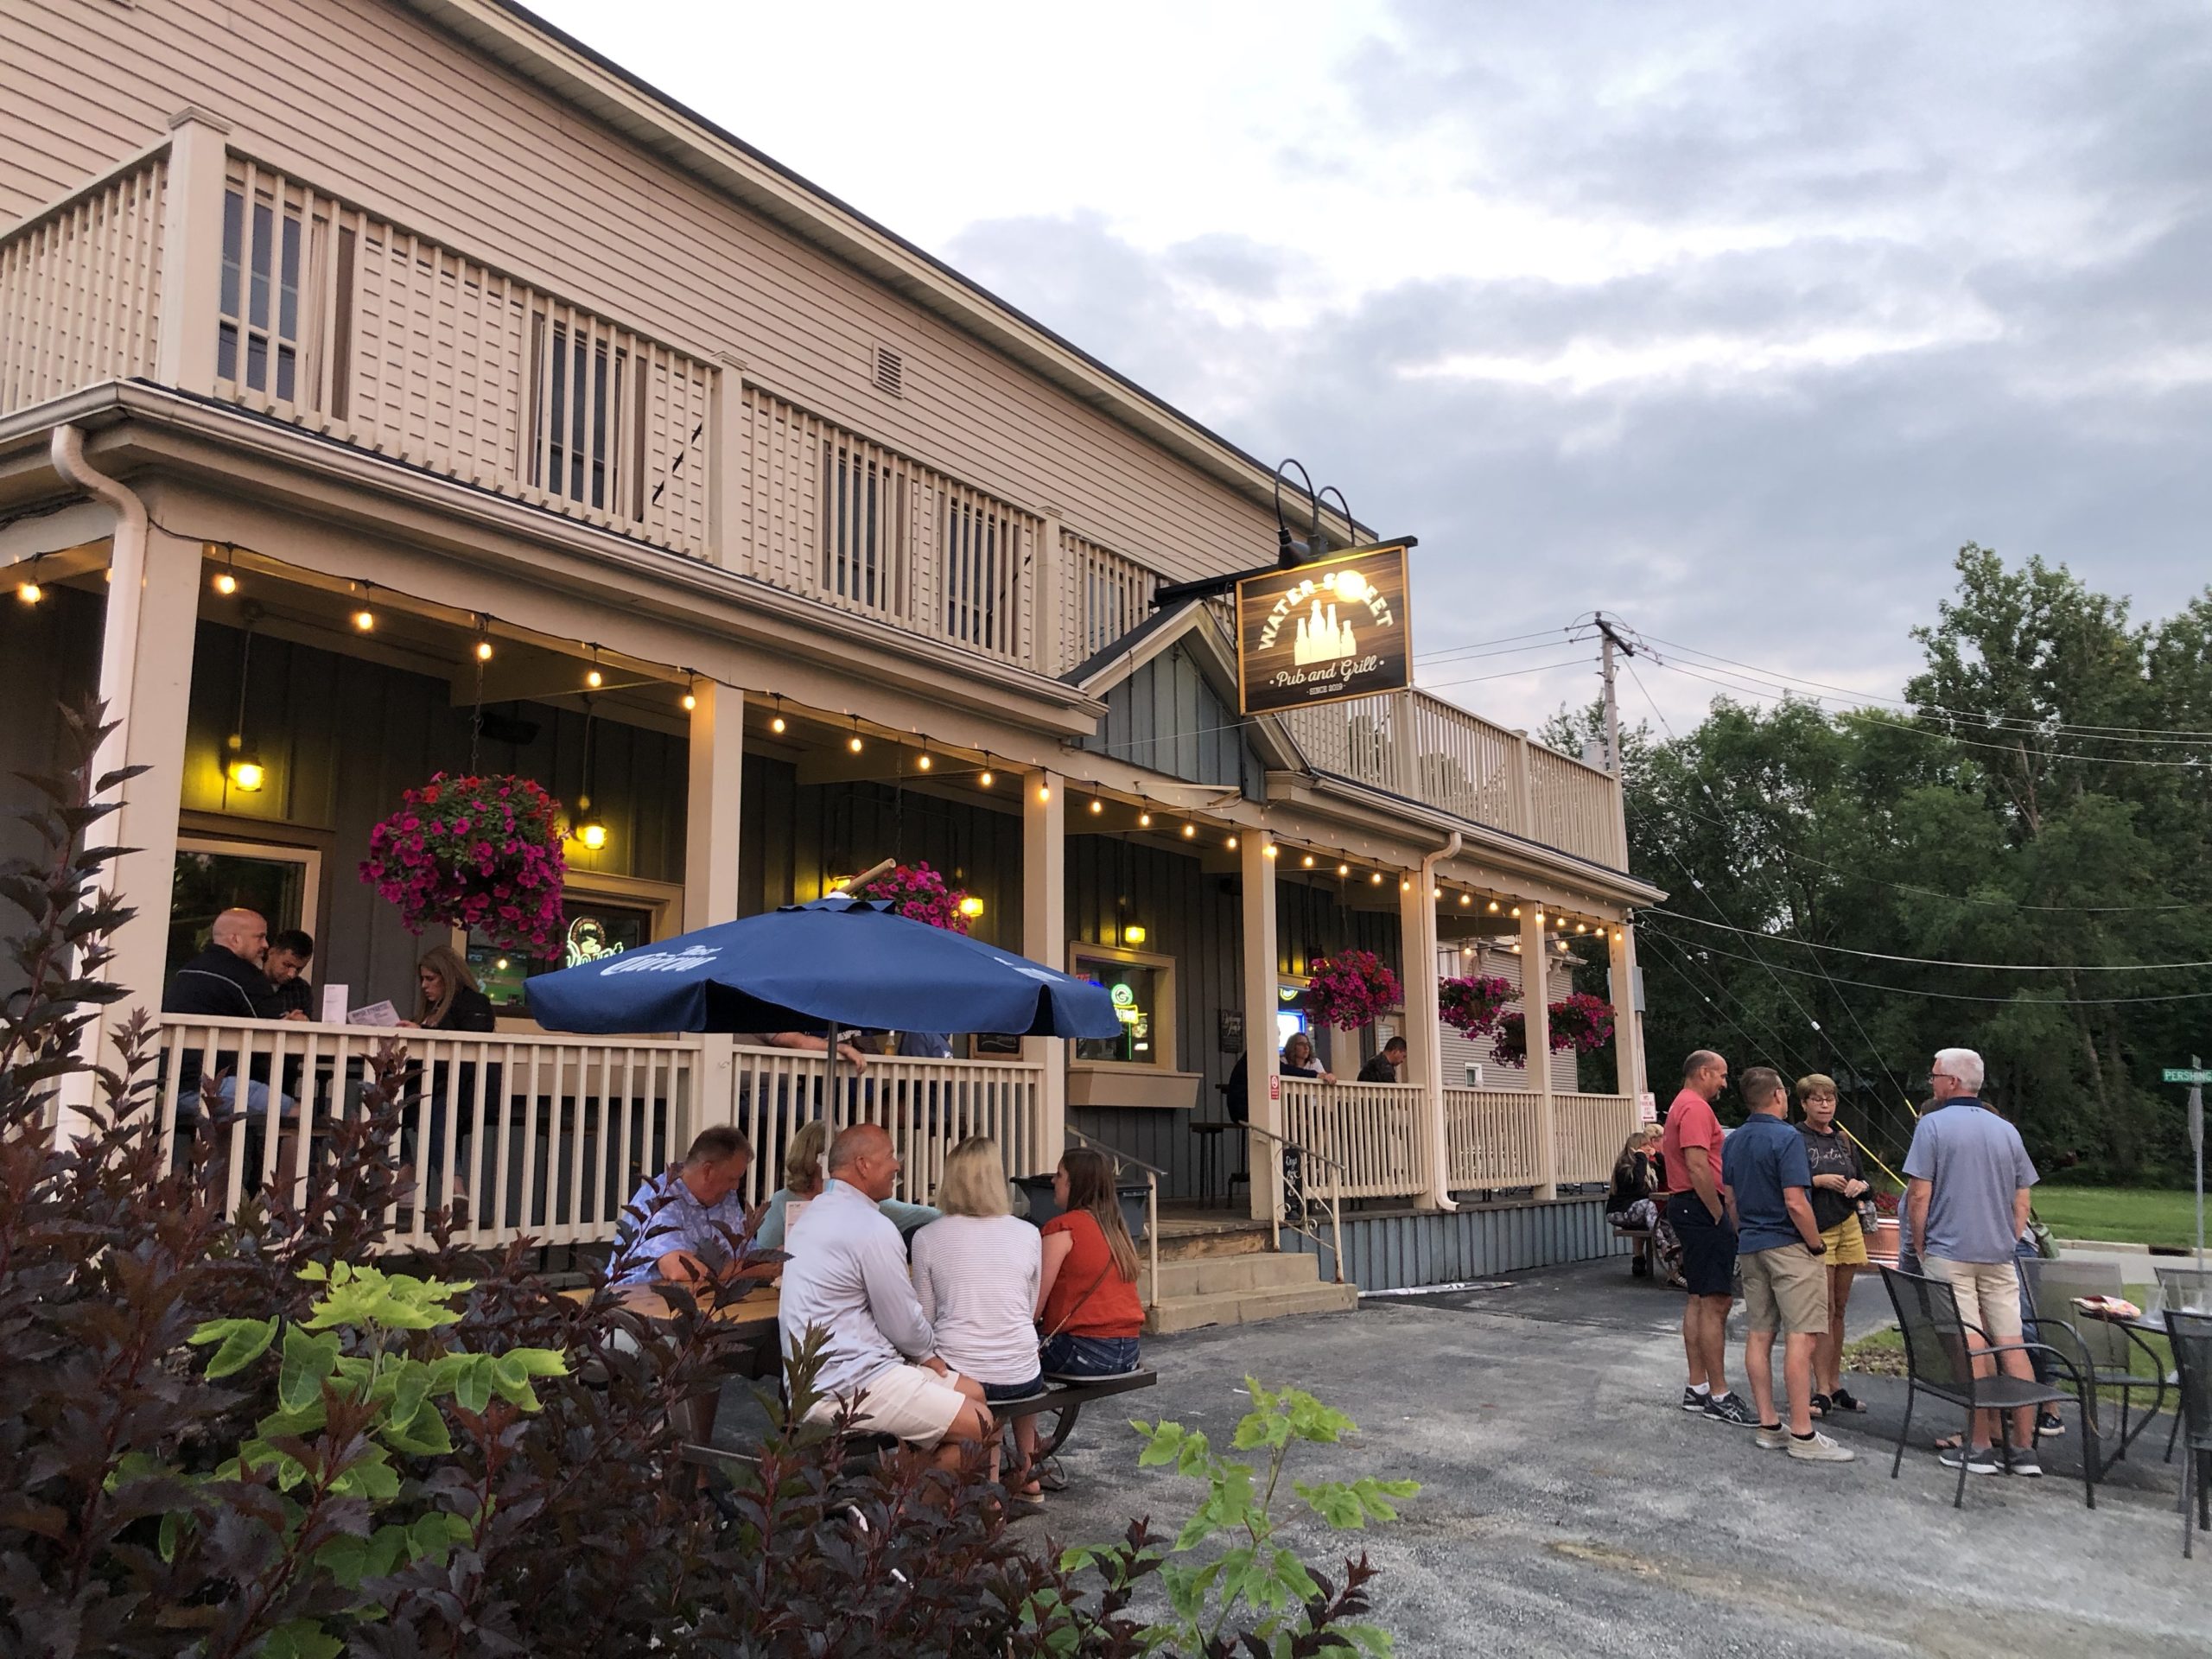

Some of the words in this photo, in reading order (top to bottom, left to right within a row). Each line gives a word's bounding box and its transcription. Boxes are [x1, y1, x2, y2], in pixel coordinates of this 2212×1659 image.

[1258, 579, 1317, 651] WATER
[1323, 572, 1394, 628] SEET
[1276, 669, 1306, 687] Pub
[1308, 662, 1337, 683] and
[1340, 655, 1377, 682] Grill
[1309, 685, 1328, 696] SINCE
